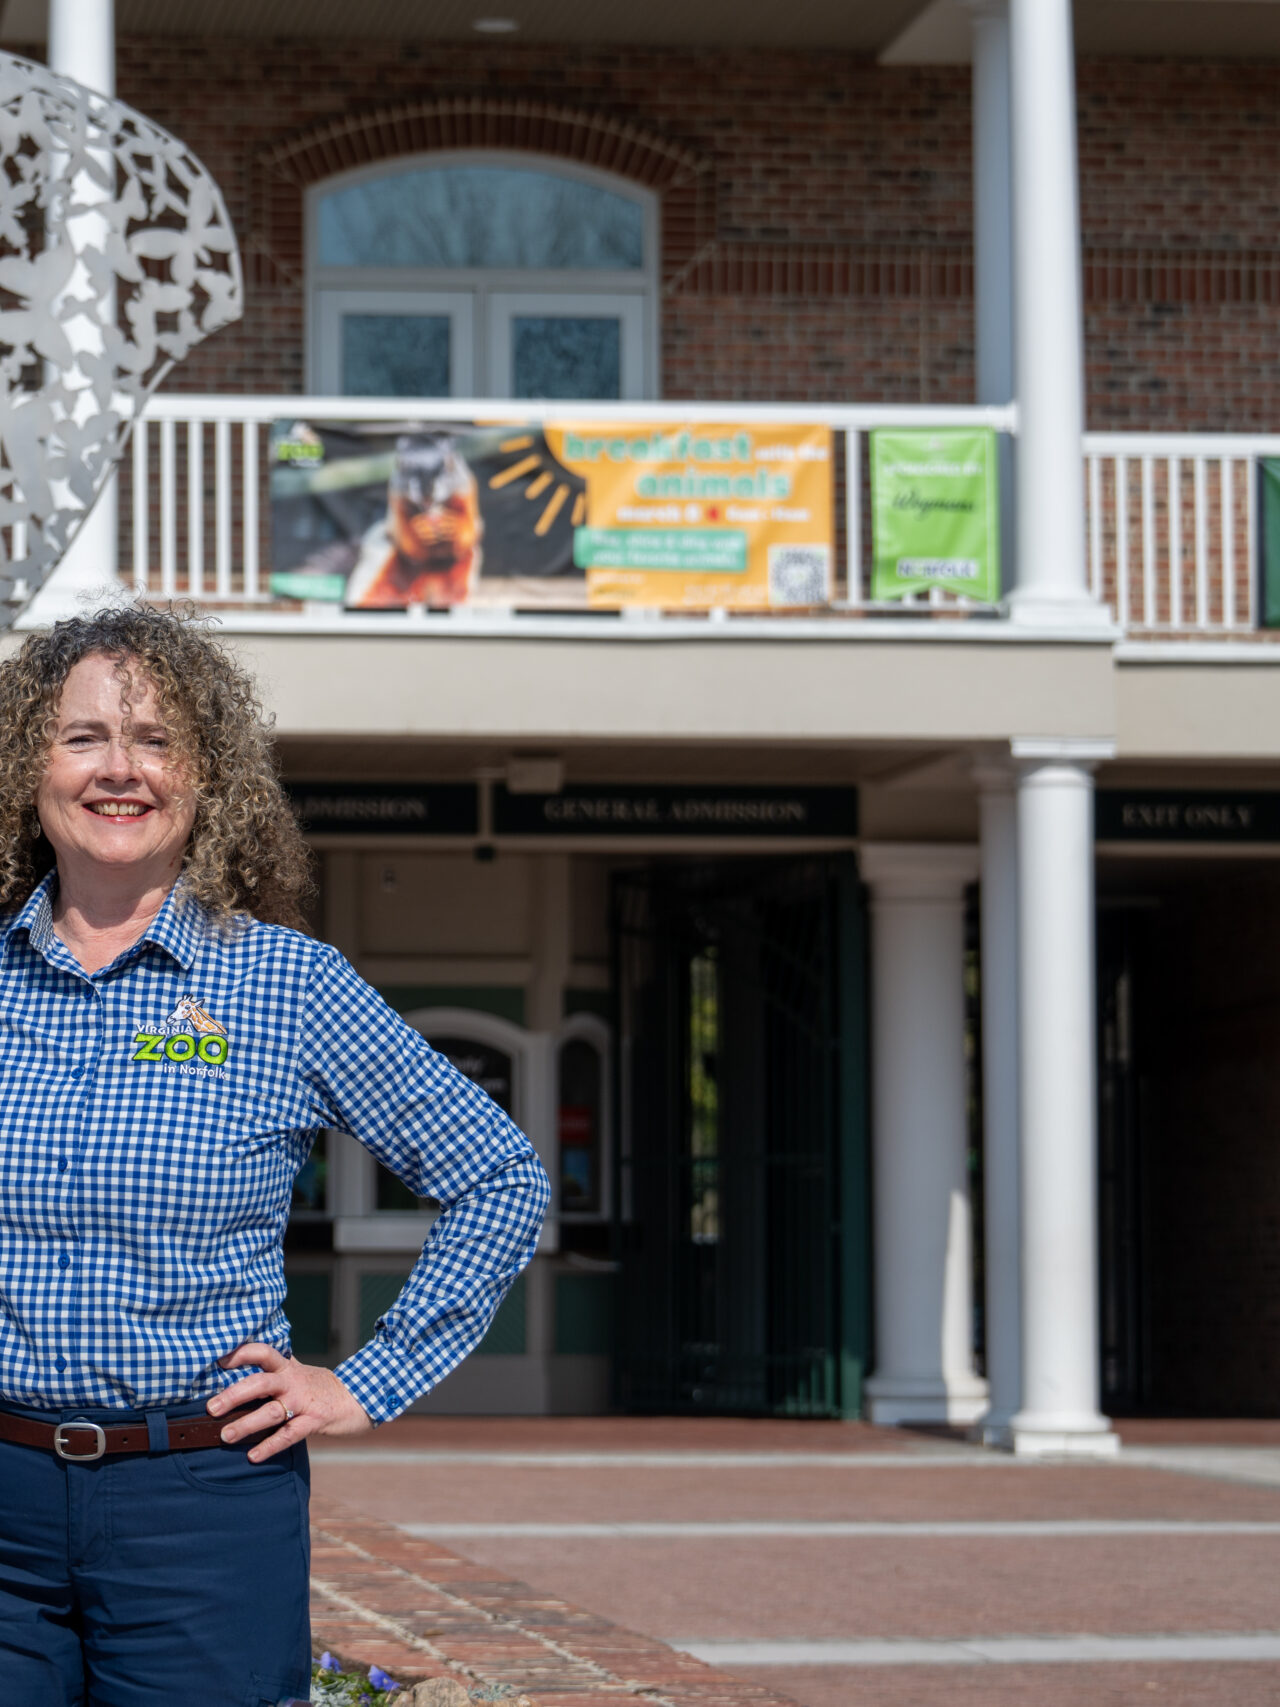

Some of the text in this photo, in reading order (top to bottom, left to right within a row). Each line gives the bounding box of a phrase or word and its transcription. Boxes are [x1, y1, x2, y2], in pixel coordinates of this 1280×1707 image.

[563, 430, 753, 462] breakfast
[634, 463, 792, 499] animals
[544, 797, 806, 823] GENERAL ADMISSION
[1122, 803, 1254, 828] EXIT ONLY
[136, 1023, 193, 1035] VIRGINIA
[131, 1032, 229, 1065] ZOO
[163, 1063, 226, 1080] in Norfolk
